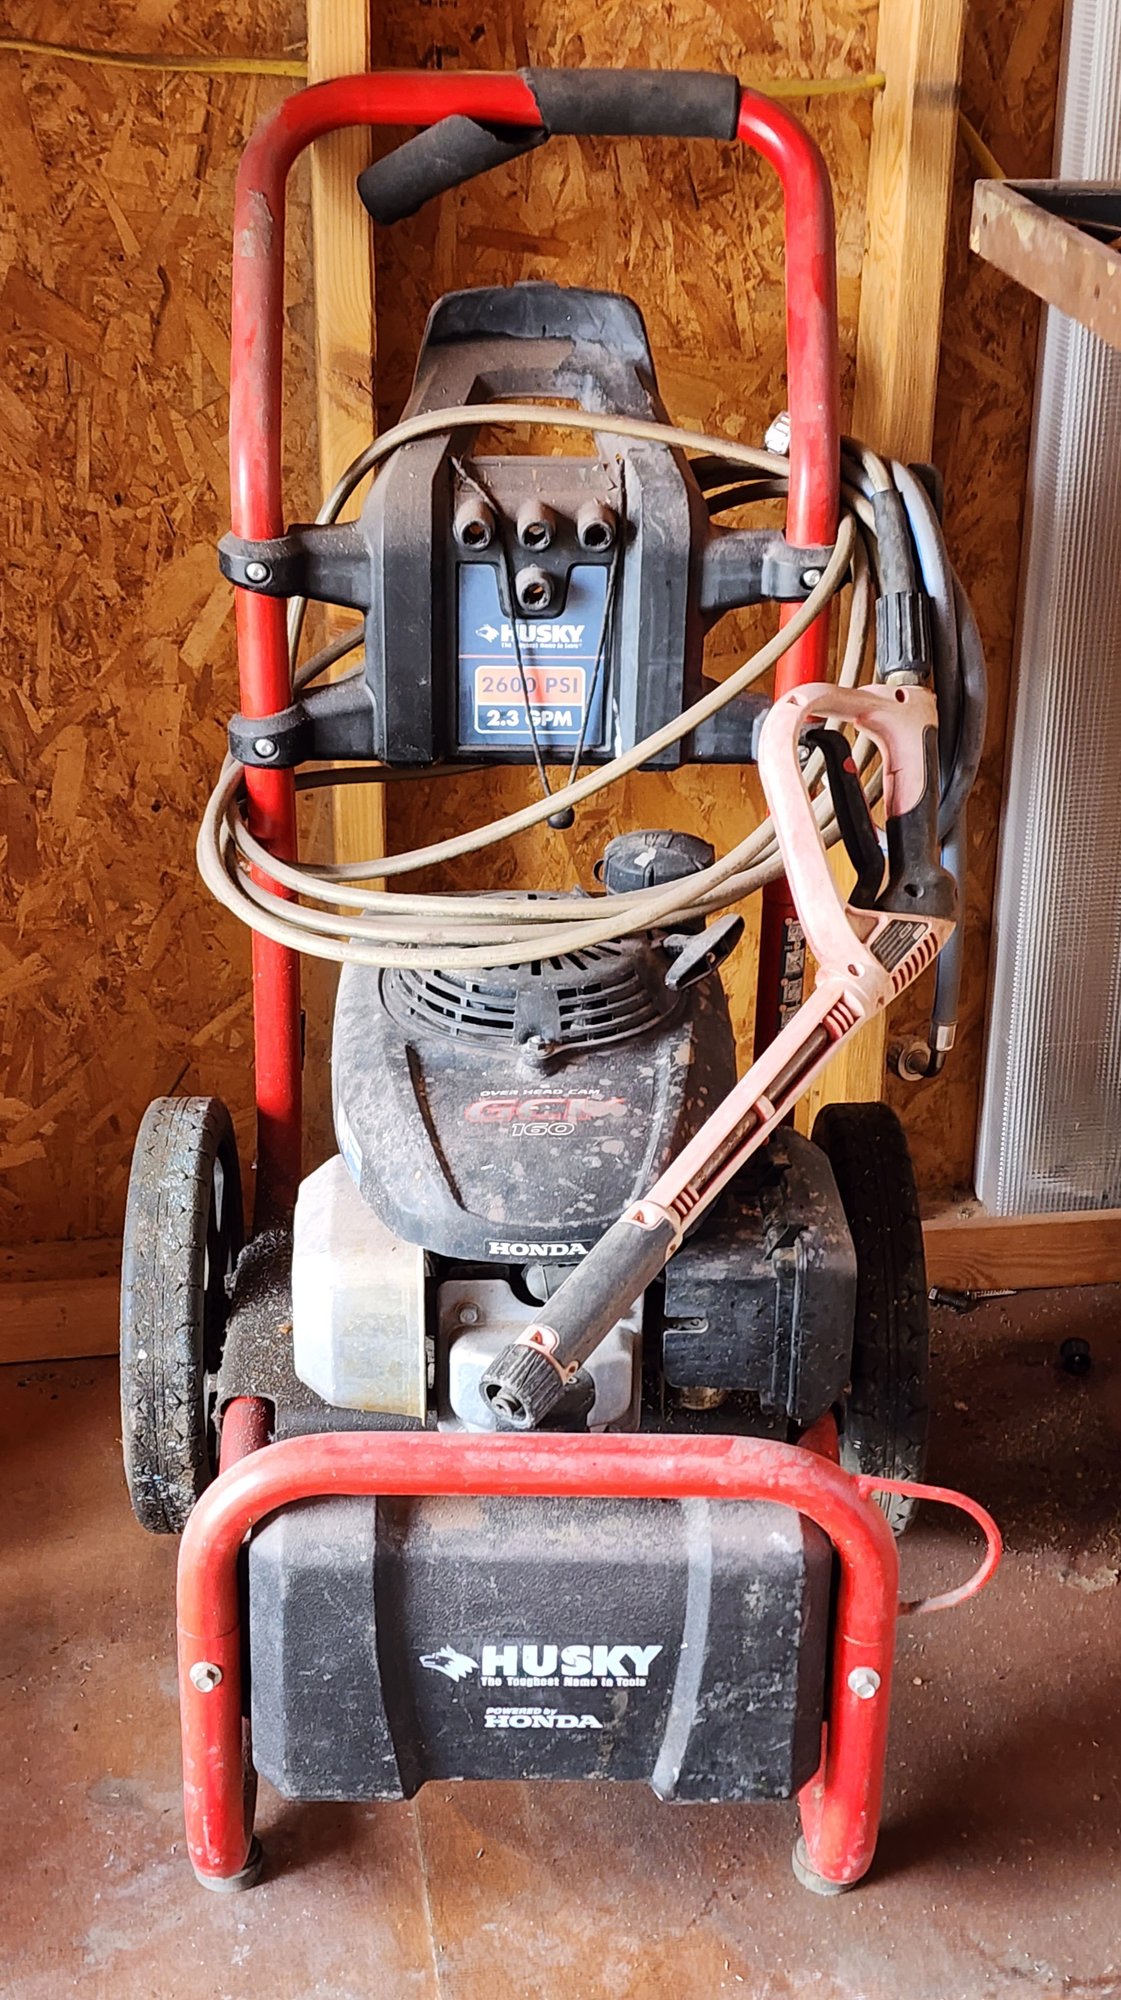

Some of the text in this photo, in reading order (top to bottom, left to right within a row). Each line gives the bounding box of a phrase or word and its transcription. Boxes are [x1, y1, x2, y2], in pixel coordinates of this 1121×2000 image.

[501, 624, 585, 643] HUSKY
[482, 677, 578, 693] 2600 PSI
[486, 709, 572, 726] 2.3 GPM
[480, 1089, 518, 1097] OVER
[512, 1122, 575, 1137] 160
[488, 1242, 589, 1256] HONDA
[481, 1644, 663, 1677] HUSKY
[480, 1676, 502, 1687] The
[506, 1676, 560, 1688] Toughest
[563, 1676, 598, 1687] Name
[616, 1676, 647, 1687] Tools
[486, 1707, 542, 1715] POWERED
[484, 1714, 604, 1729] HONDA
